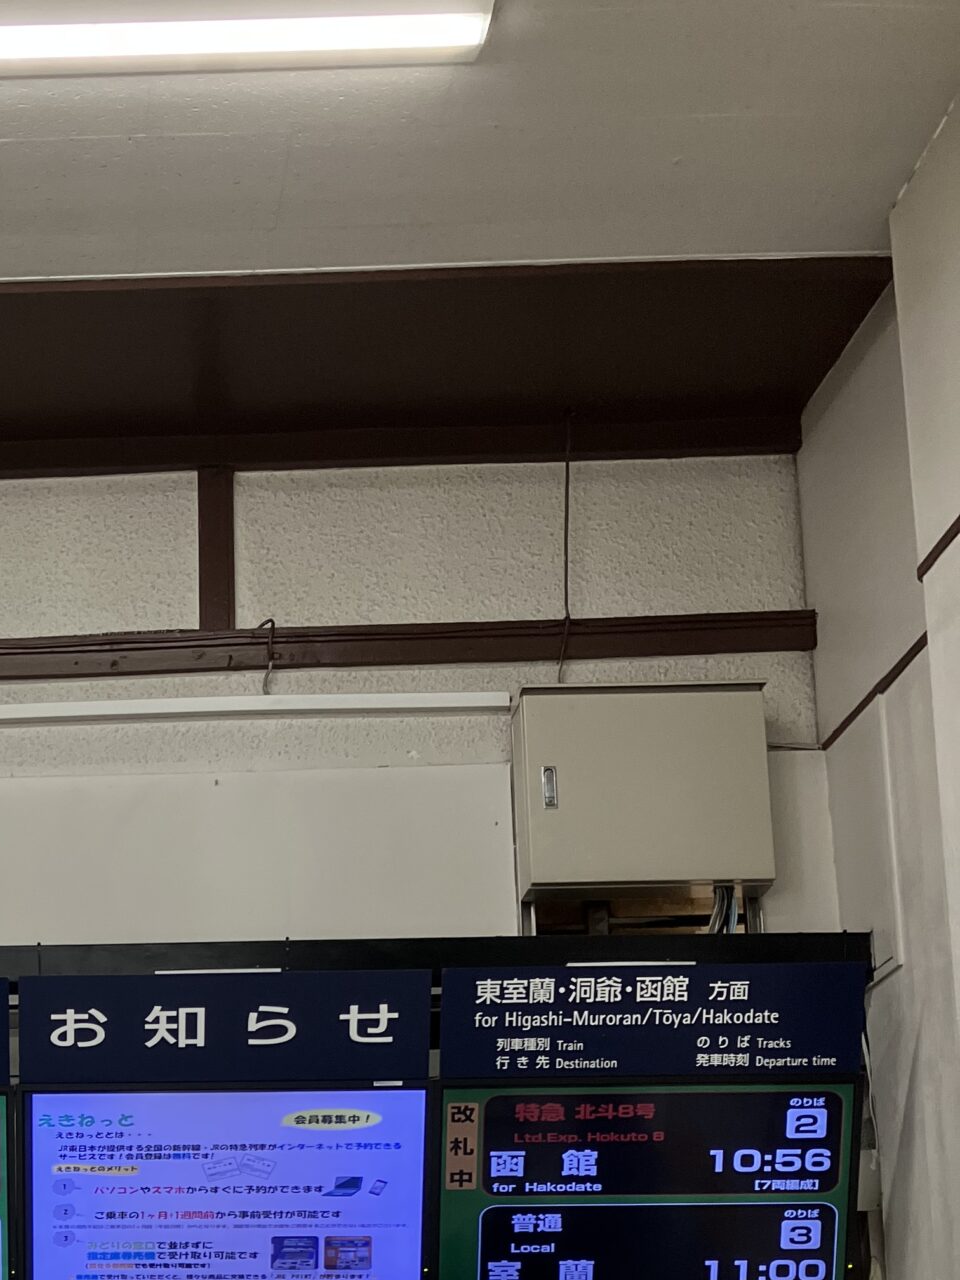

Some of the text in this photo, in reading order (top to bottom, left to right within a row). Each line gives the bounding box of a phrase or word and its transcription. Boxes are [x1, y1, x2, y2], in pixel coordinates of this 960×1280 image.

[475, 976, 749, 1004] 東室蘭・洞爺・函館 方面
[50, 1004, 399, 1048] お知らせ
[475, 1012, 498, 1027] for
[496, 1038, 583, 1051] 列車種別 Train
[697, 1036, 791, 1048] のりば Tracks
[496, 1056, 617, 1069] 行き先 Destination
[696, 1054, 836, 1068] 発車時刻 Departure time
[790, 1098, 825, 1106] のりば
[515, 1104, 564, 1121] 特急
[39, 1114, 134, 1127] えきねっと
[795, 1115, 818, 1133] 2
[515, 1133, 582, 1144] Ltd.Exp.
[587, 1132, 648, 1142] Hokuto
[449, 1105, 475, 1187] 改札中
[491, 1150, 598, 1177] 函館
[710, 1149, 831, 1171] 10:56
[493, 1182, 602, 1192] for Hakodate
[784, 1209, 819, 1218] のりば
[511, 1214, 562, 1232] 普通
[789, 1226, 812, 1244] 3
[511, 1243, 554, 1253] Local
